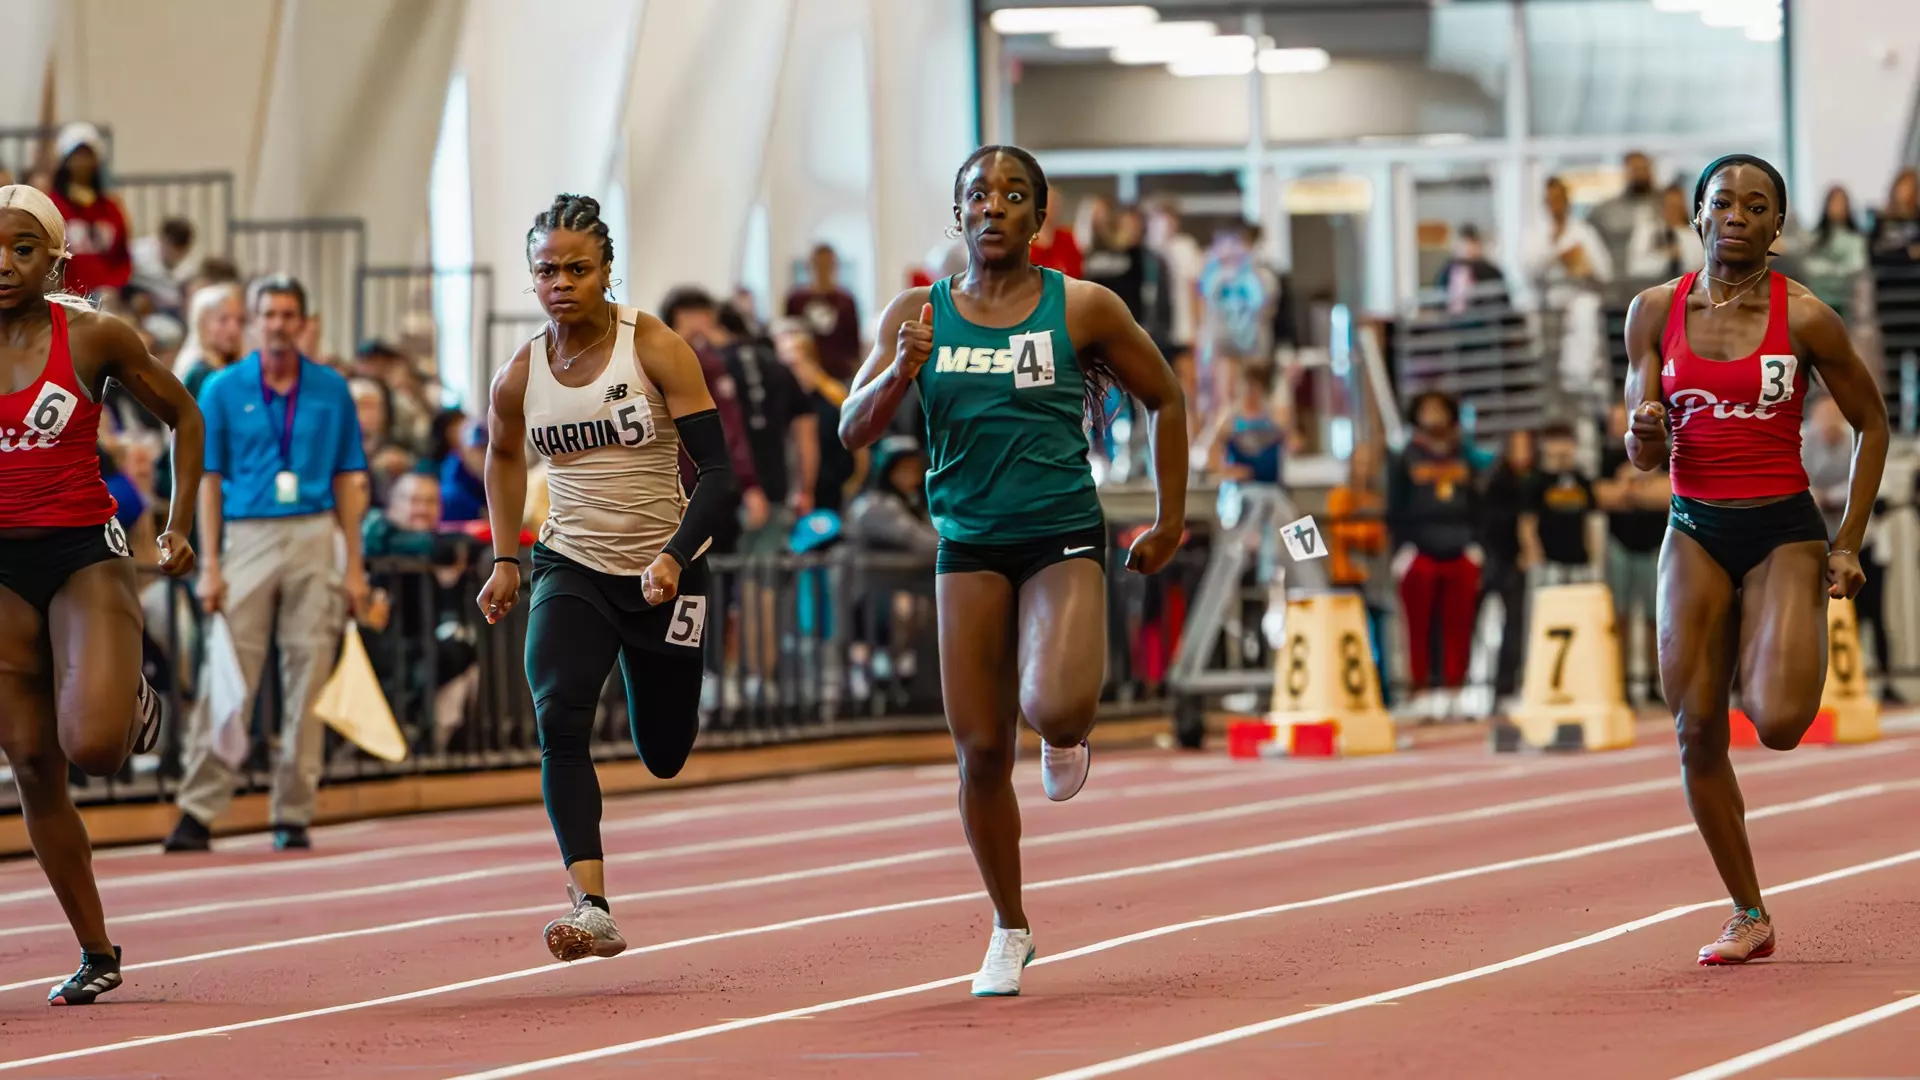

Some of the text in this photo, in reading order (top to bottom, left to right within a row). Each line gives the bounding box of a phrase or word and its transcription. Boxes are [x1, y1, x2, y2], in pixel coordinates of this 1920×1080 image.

[935, 346, 1015, 373] MSS
[1017, 340, 1042, 381] 4
[1763, 360, 1786, 401] 3
[34, 392, 66, 430] 6
[617, 405, 644, 445] 5
[531, 419, 621, 456] HARDIN
[1295, 525, 1315, 554] 4
[671, 600, 698, 641] 5
[1340, 632, 1365, 697] 8
[1546, 628, 1573, 690] 7
